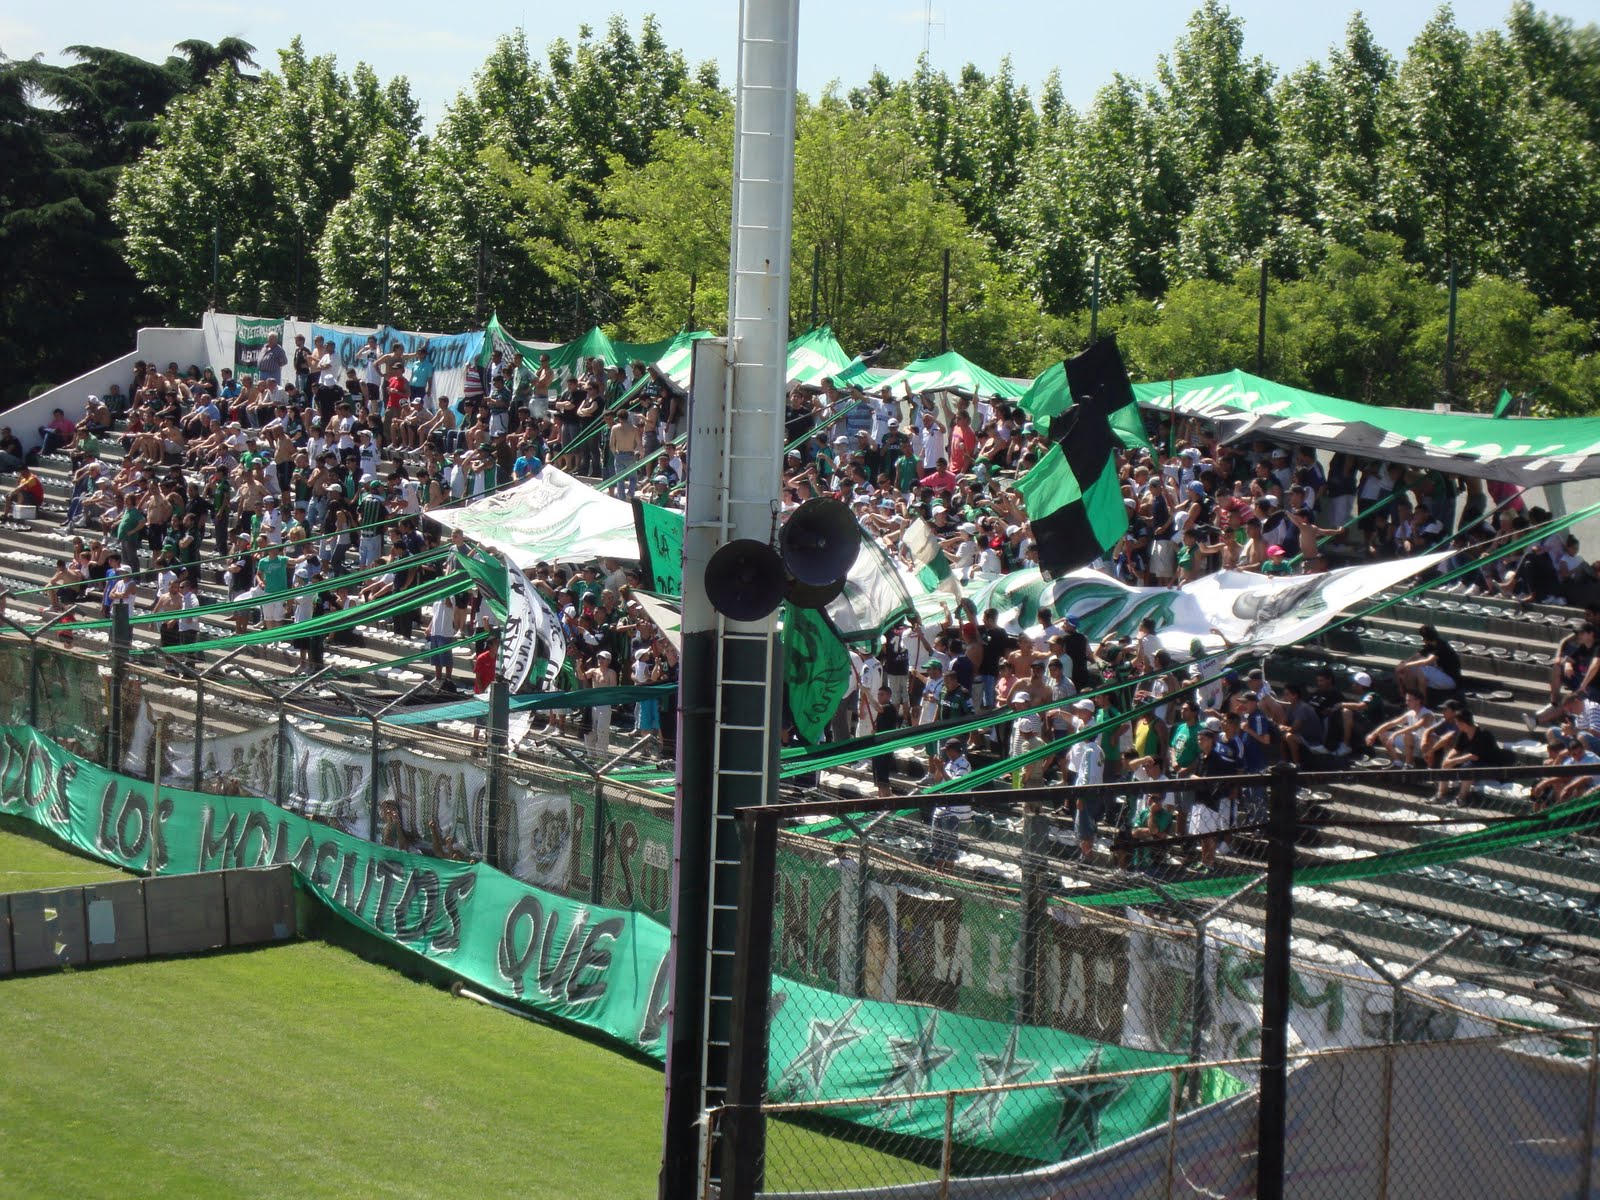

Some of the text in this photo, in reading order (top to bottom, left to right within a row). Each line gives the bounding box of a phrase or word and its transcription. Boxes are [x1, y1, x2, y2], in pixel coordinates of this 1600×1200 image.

[96, 779, 174, 872] LOS
[199, 804, 477, 951] MOMENTOS
[497, 894, 626, 1006] QUE
